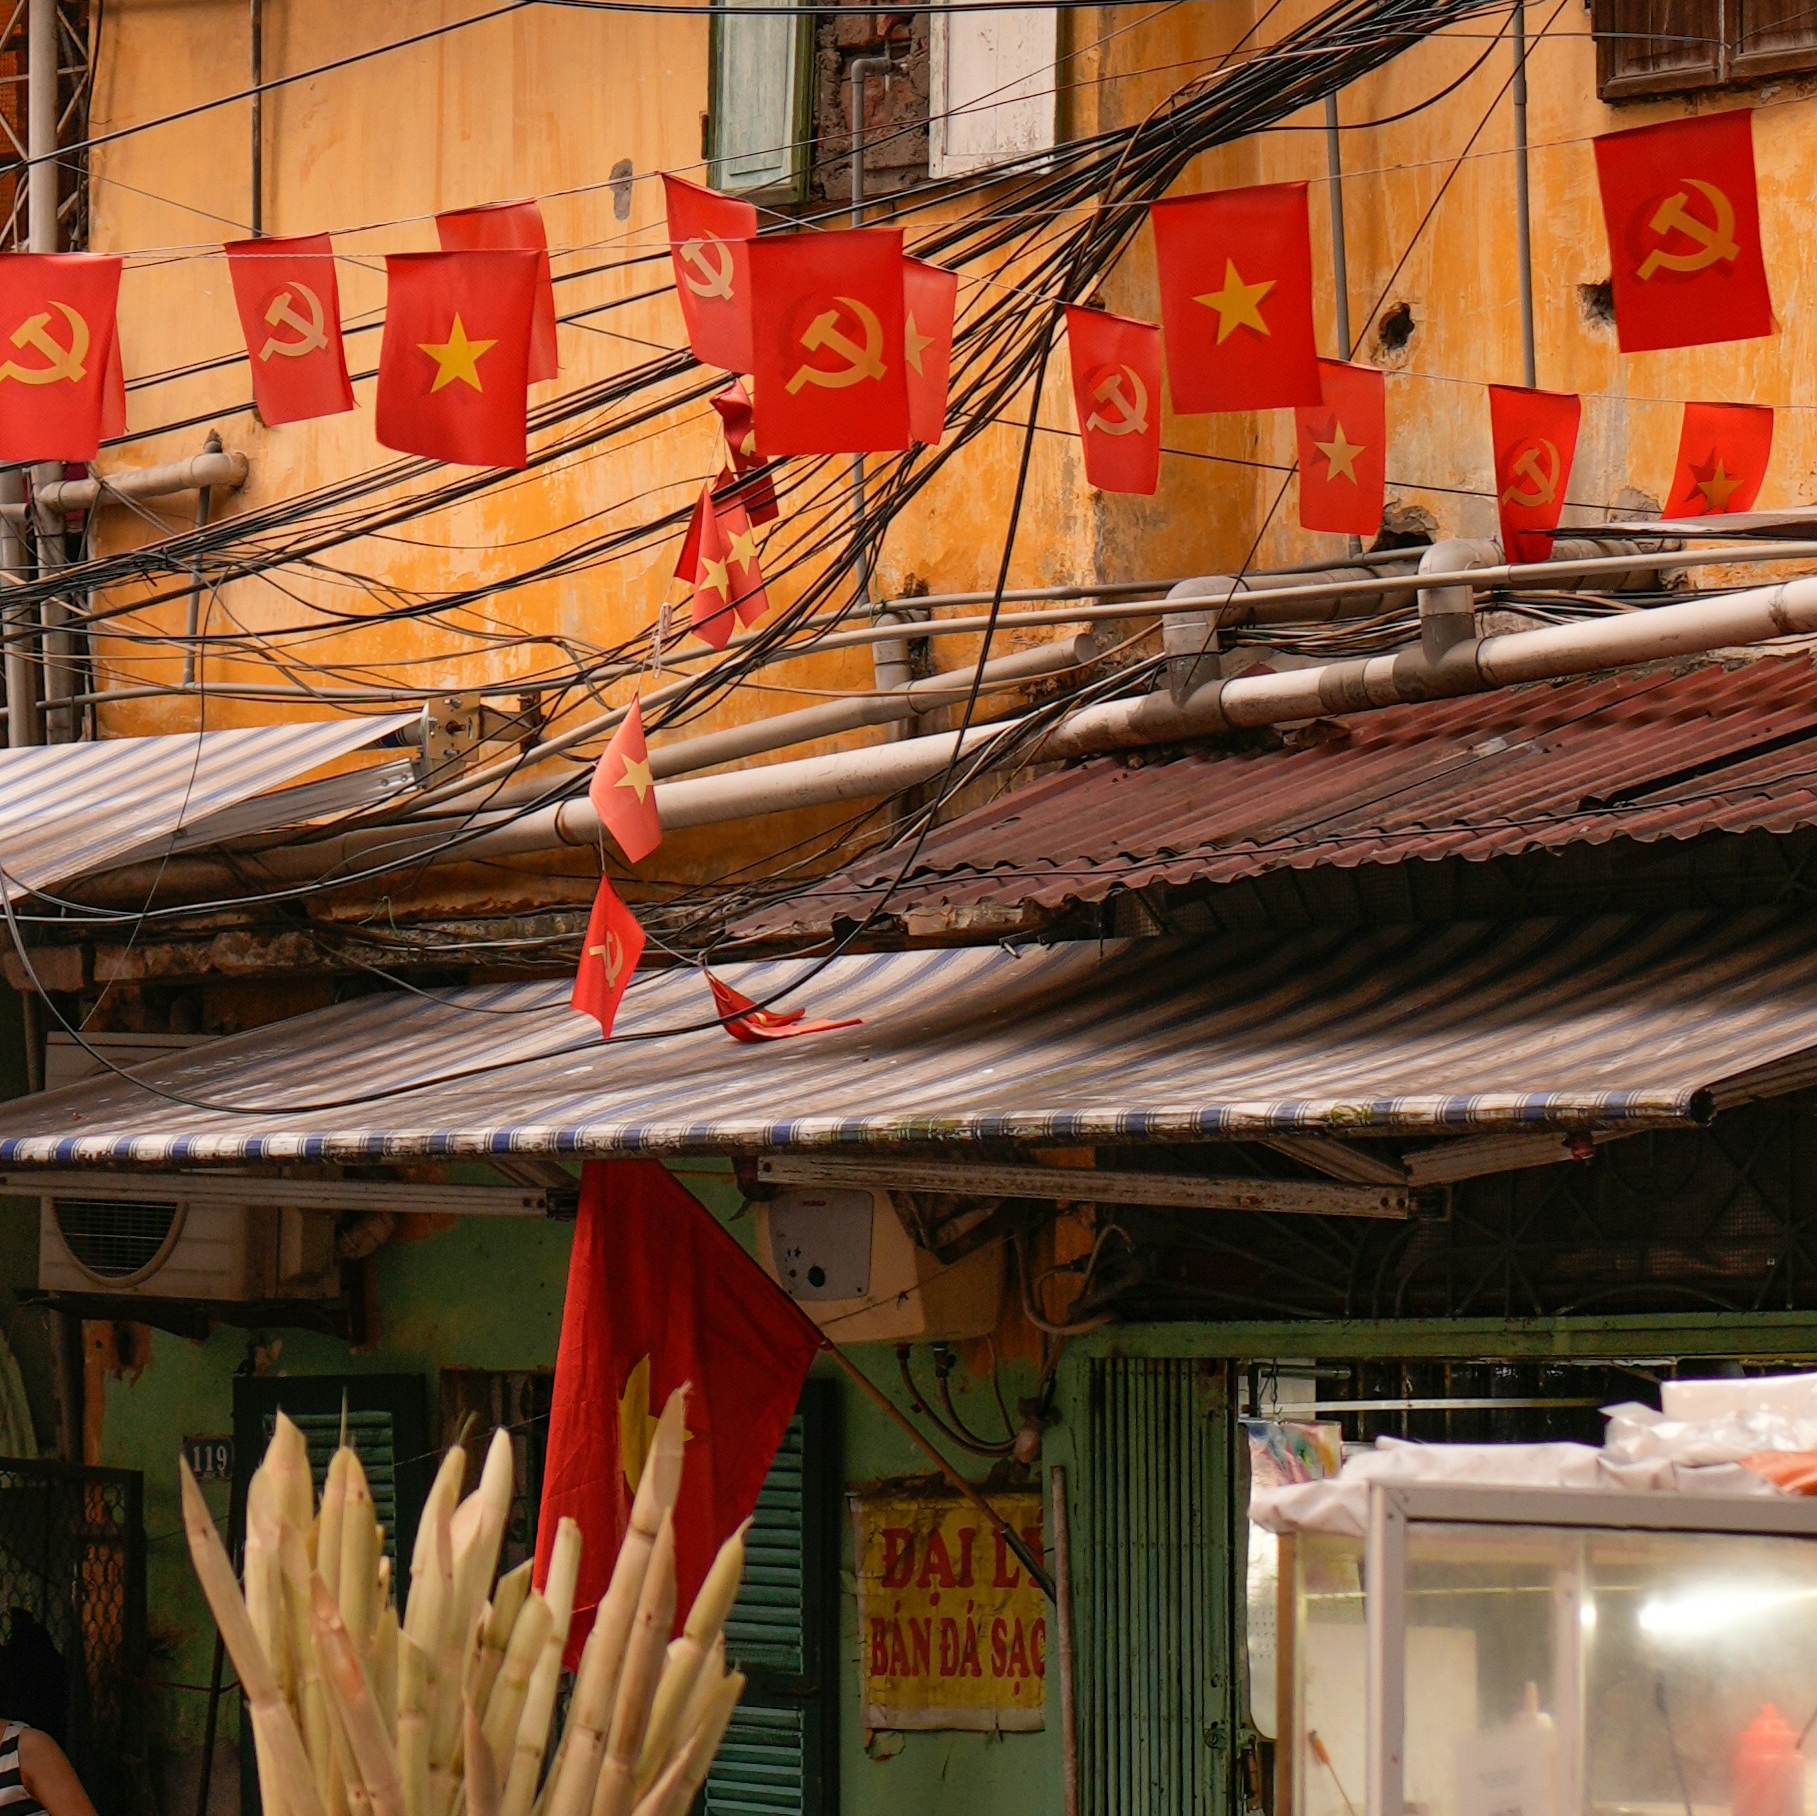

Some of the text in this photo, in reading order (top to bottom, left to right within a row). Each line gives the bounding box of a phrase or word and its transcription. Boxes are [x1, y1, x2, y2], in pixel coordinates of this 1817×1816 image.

[192, 1445, 228, 1473] 119
[881, 1526, 977, 1607] ĐẠI
[870, 1599, 932, 1677] BÁN
[939, 1599, 983, 1678] ĐÁ
